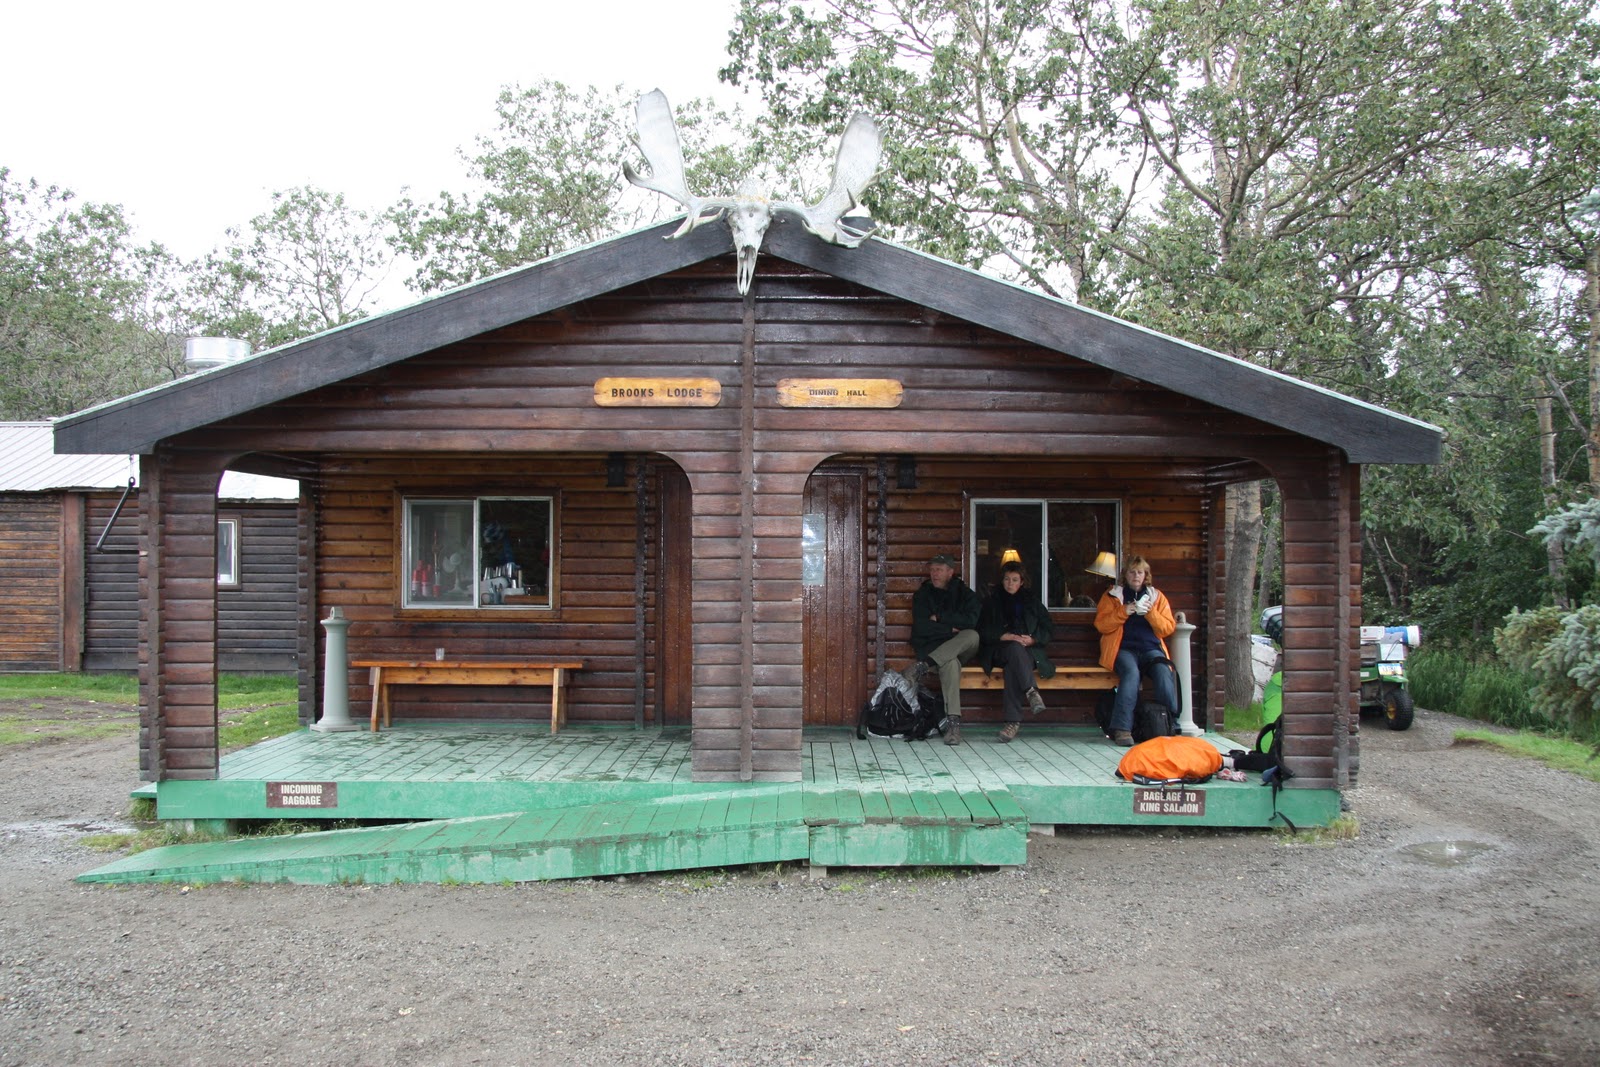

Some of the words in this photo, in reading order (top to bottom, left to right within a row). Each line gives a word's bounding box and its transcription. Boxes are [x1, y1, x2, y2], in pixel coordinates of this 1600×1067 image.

[611, 388, 654, 398] BROOKS
[667, 388, 702, 398] LODGE
[281, 784, 323, 794] INCOMING
[282, 795, 322, 805] BAGGAGE
[1185, 792, 1197, 802] TO
[1140, 802, 1161, 812] KING
[1163, 802, 1199, 813] SALMON
